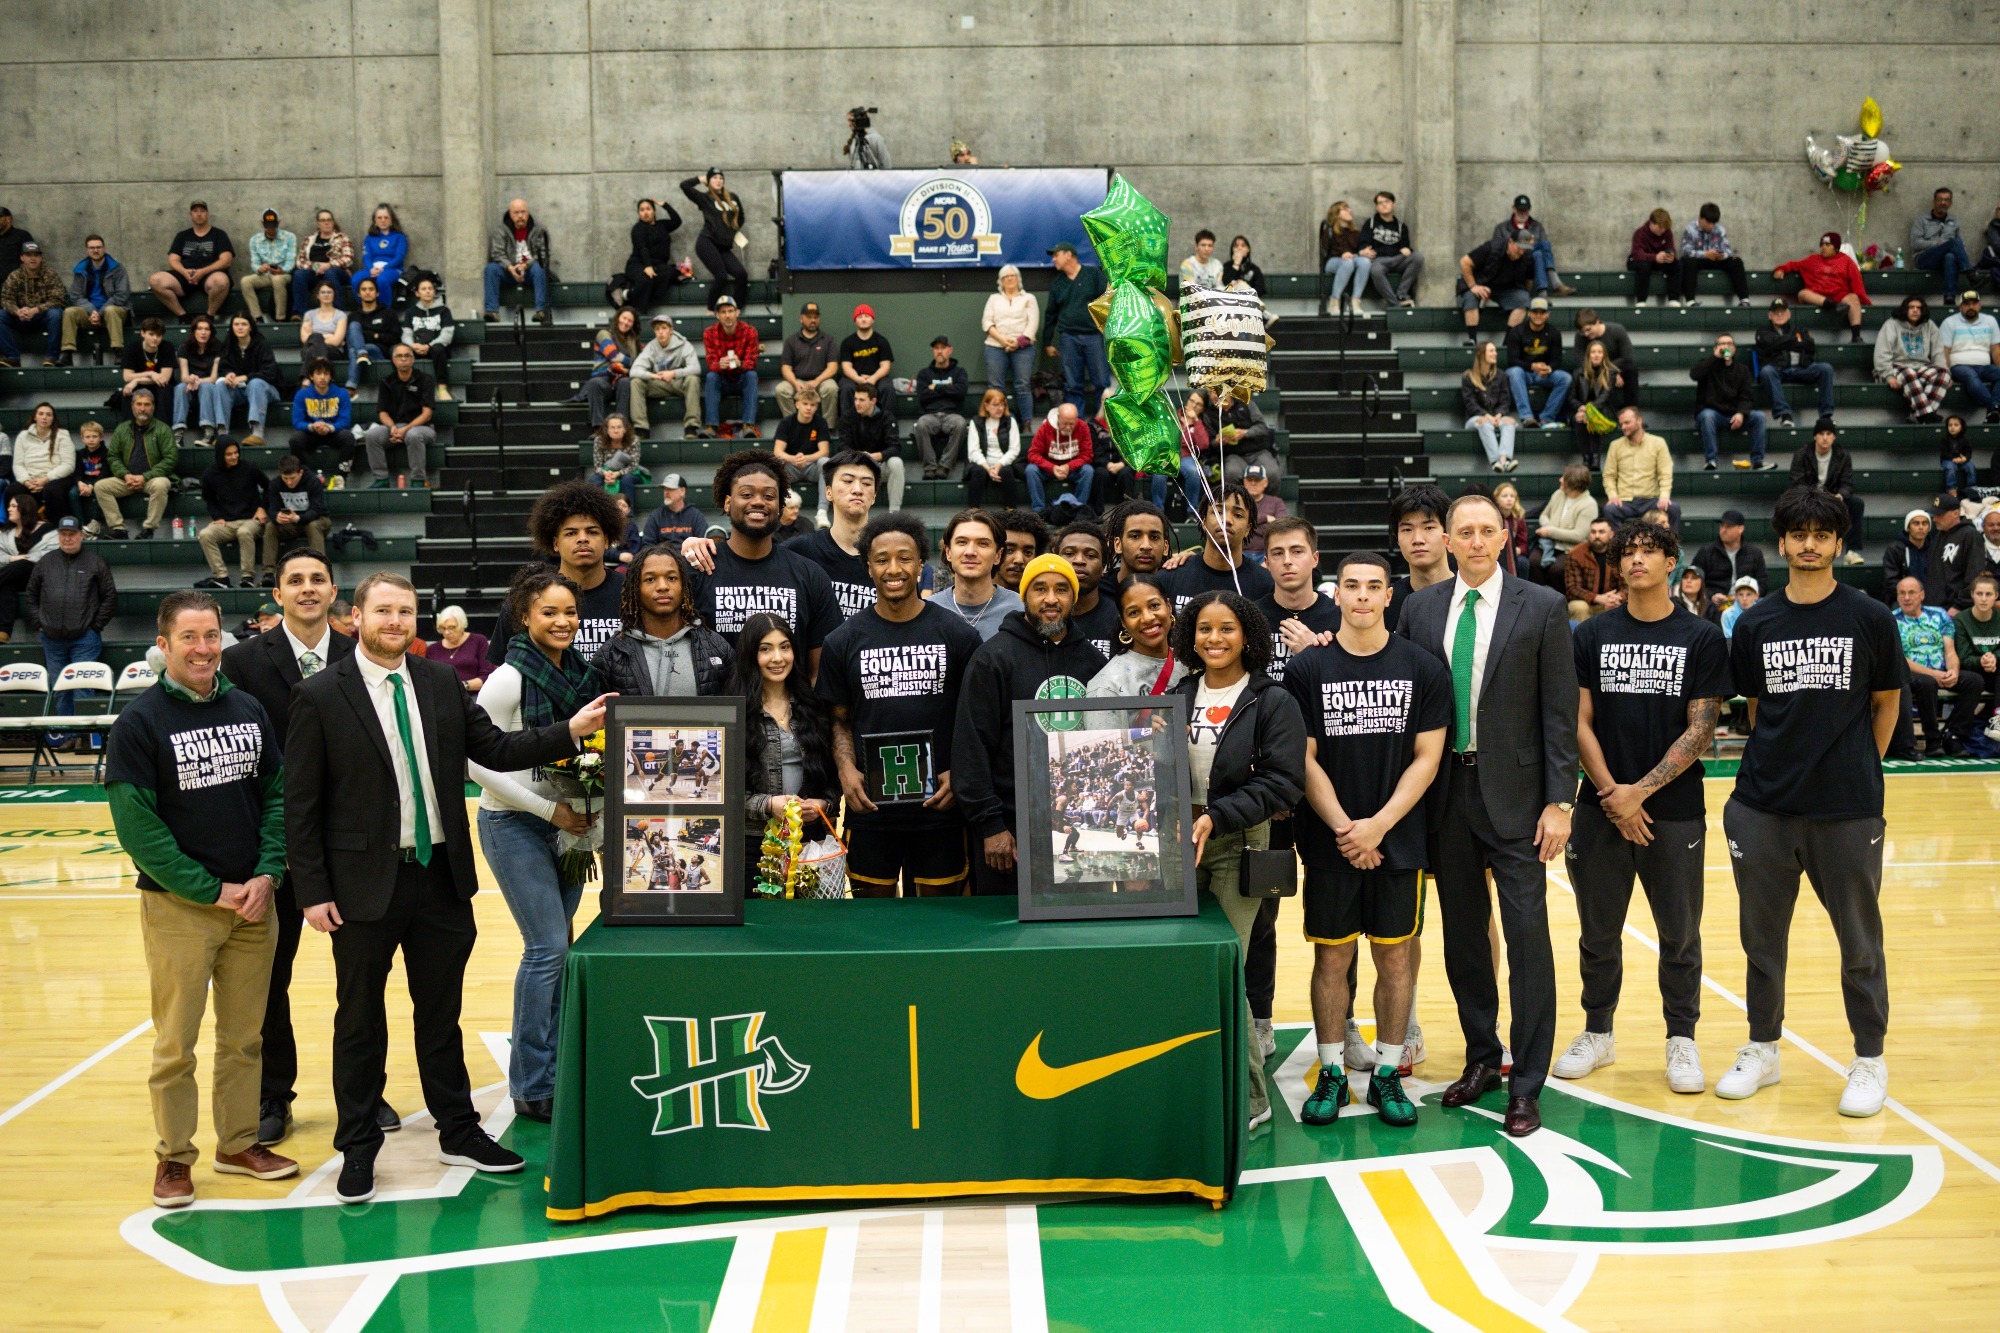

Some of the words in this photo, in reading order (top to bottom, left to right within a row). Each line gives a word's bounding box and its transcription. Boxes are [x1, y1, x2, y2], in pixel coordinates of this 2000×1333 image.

[920, 184, 962, 197] DIVISION
[934, 197, 956, 205] NCAA
[923, 207, 968, 240] 50
[716, 586, 753, 595] UNITY
[756, 586, 789, 596] PEACE
[850, 584, 877, 596] PEAC
[716, 595, 789, 610] EQUALITY
[584, 618, 618, 628] PEACE
[716, 624, 744, 632] OVERCO
[574, 628, 617, 643] ALITY
[1601, 643, 1641, 653] UNITY
[1642, 644, 1678, 655] PEACE
[1762, 639, 1803, 653] UNITY
[1806, 637, 1844, 648] PEACE
[860, 646, 900, 659] UNITY
[902, 645, 938, 656] PEACE
[860, 654, 937, 675] EQUALITY
[1600, 653, 1677, 670] EQUALITY
[1763, 648, 1843, 670] EQUALITY
[1842, 637, 1854, 690] HUMBOLDT
[11, 671, 42, 680] PEPSI
[76, 669, 105, 678] PEPSI
[899, 670, 937, 680] FREEDOM
[937, 644, 947, 694] HUMBOLDT
[1636, 669, 1672, 680] FREEDOM
[1673, 647, 1687, 697] HUMBOLDT
[1801, 664, 1840, 674] FREEDOM
[861, 675, 878, 683] BLACK
[898, 680, 932, 691] JUSTICE
[1635, 679, 1666, 689] JUSTICE
[1800, 674, 1834, 684] JUSTICE
[865, 687, 899, 699] OVERCOME
[1322, 680, 1364, 693] UNITY
[1367, 680, 1405, 690] PEACE
[1600, 682, 1636, 693] OVERCOME
[1322, 690, 1404, 711] EQUALITY
[1191, 706, 1206, 723] I
[1324, 711, 1342, 719] BLACK
[1363, 707, 1401, 718] FREEDOM
[170, 727, 213, 745] UNITY
[216, 723, 252, 737] PEACE
[1188, 726, 1225, 745] NY
[1325, 725, 1364, 736] OVERCOME
[174, 734, 254, 762] EQUALITY
[219, 751, 256, 766] FREEDOM
[177, 762, 198, 772] BLACK
[220, 763, 253, 777] JUSTICE
[879, 744, 923, 795] H
[180, 774, 222, 791] OVERCOME
[0, 829, 117, 837] OOD
[643, 1012, 771, 1136] H
